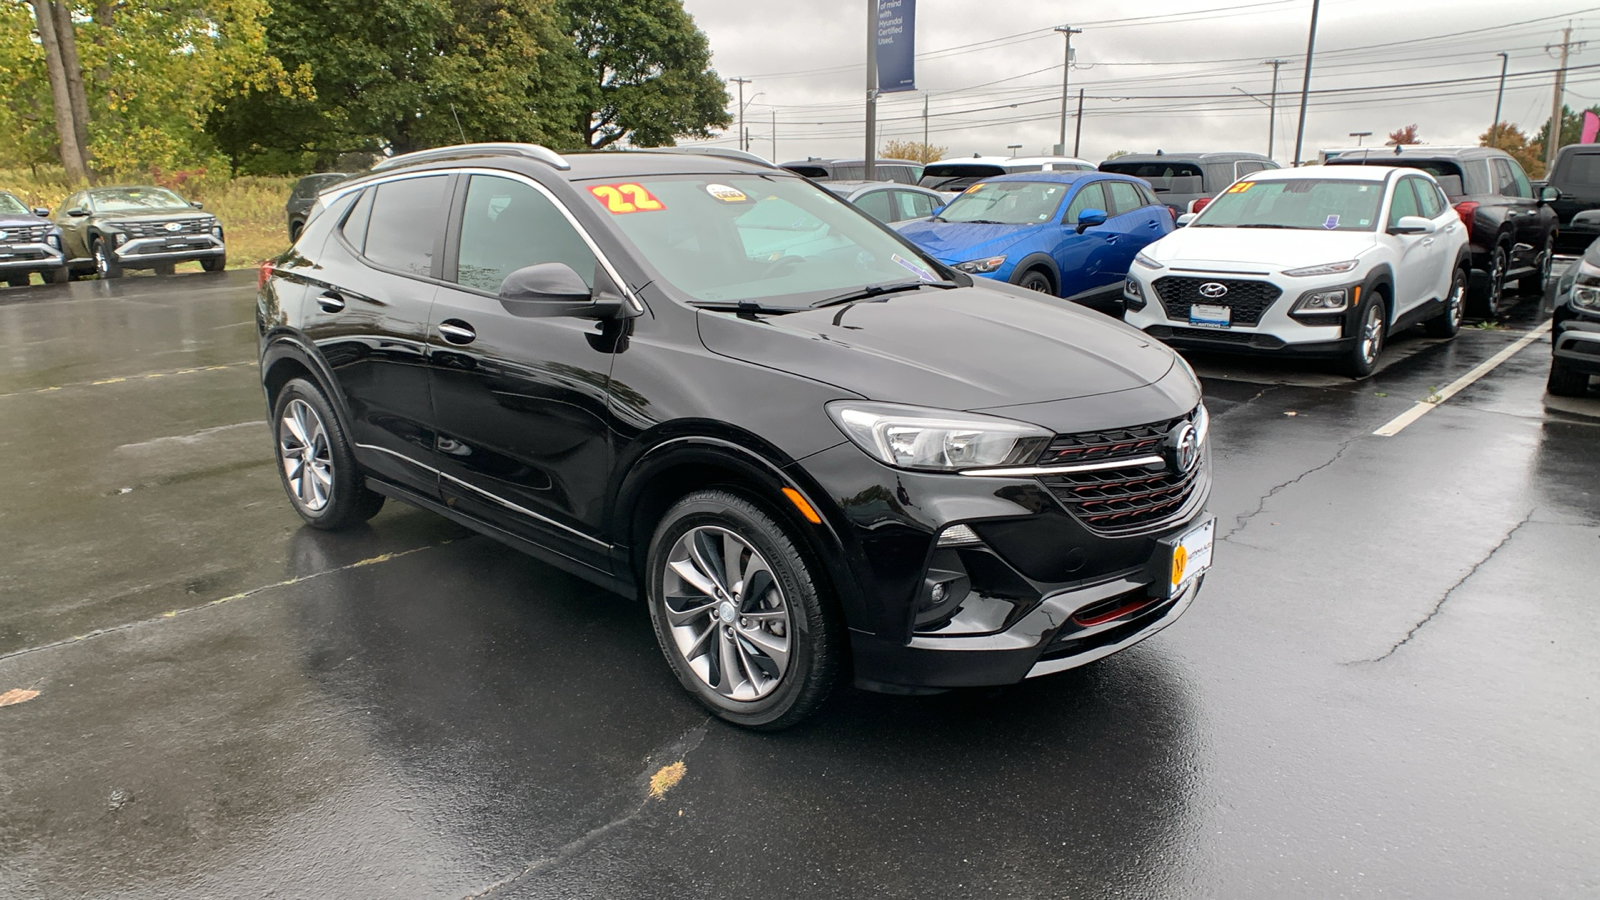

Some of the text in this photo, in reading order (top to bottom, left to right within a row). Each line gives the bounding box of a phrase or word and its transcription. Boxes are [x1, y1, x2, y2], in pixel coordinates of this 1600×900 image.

[886, 0, 902, 8] mind
[880, 10, 892, 18] with
[878, 16, 903, 28] Hyundai
[878, 25, 903, 36] Certified
[1228, 182, 1256, 194] 21
[592, 184, 662, 212] 22
[1174, 554, 1185, 577] M
